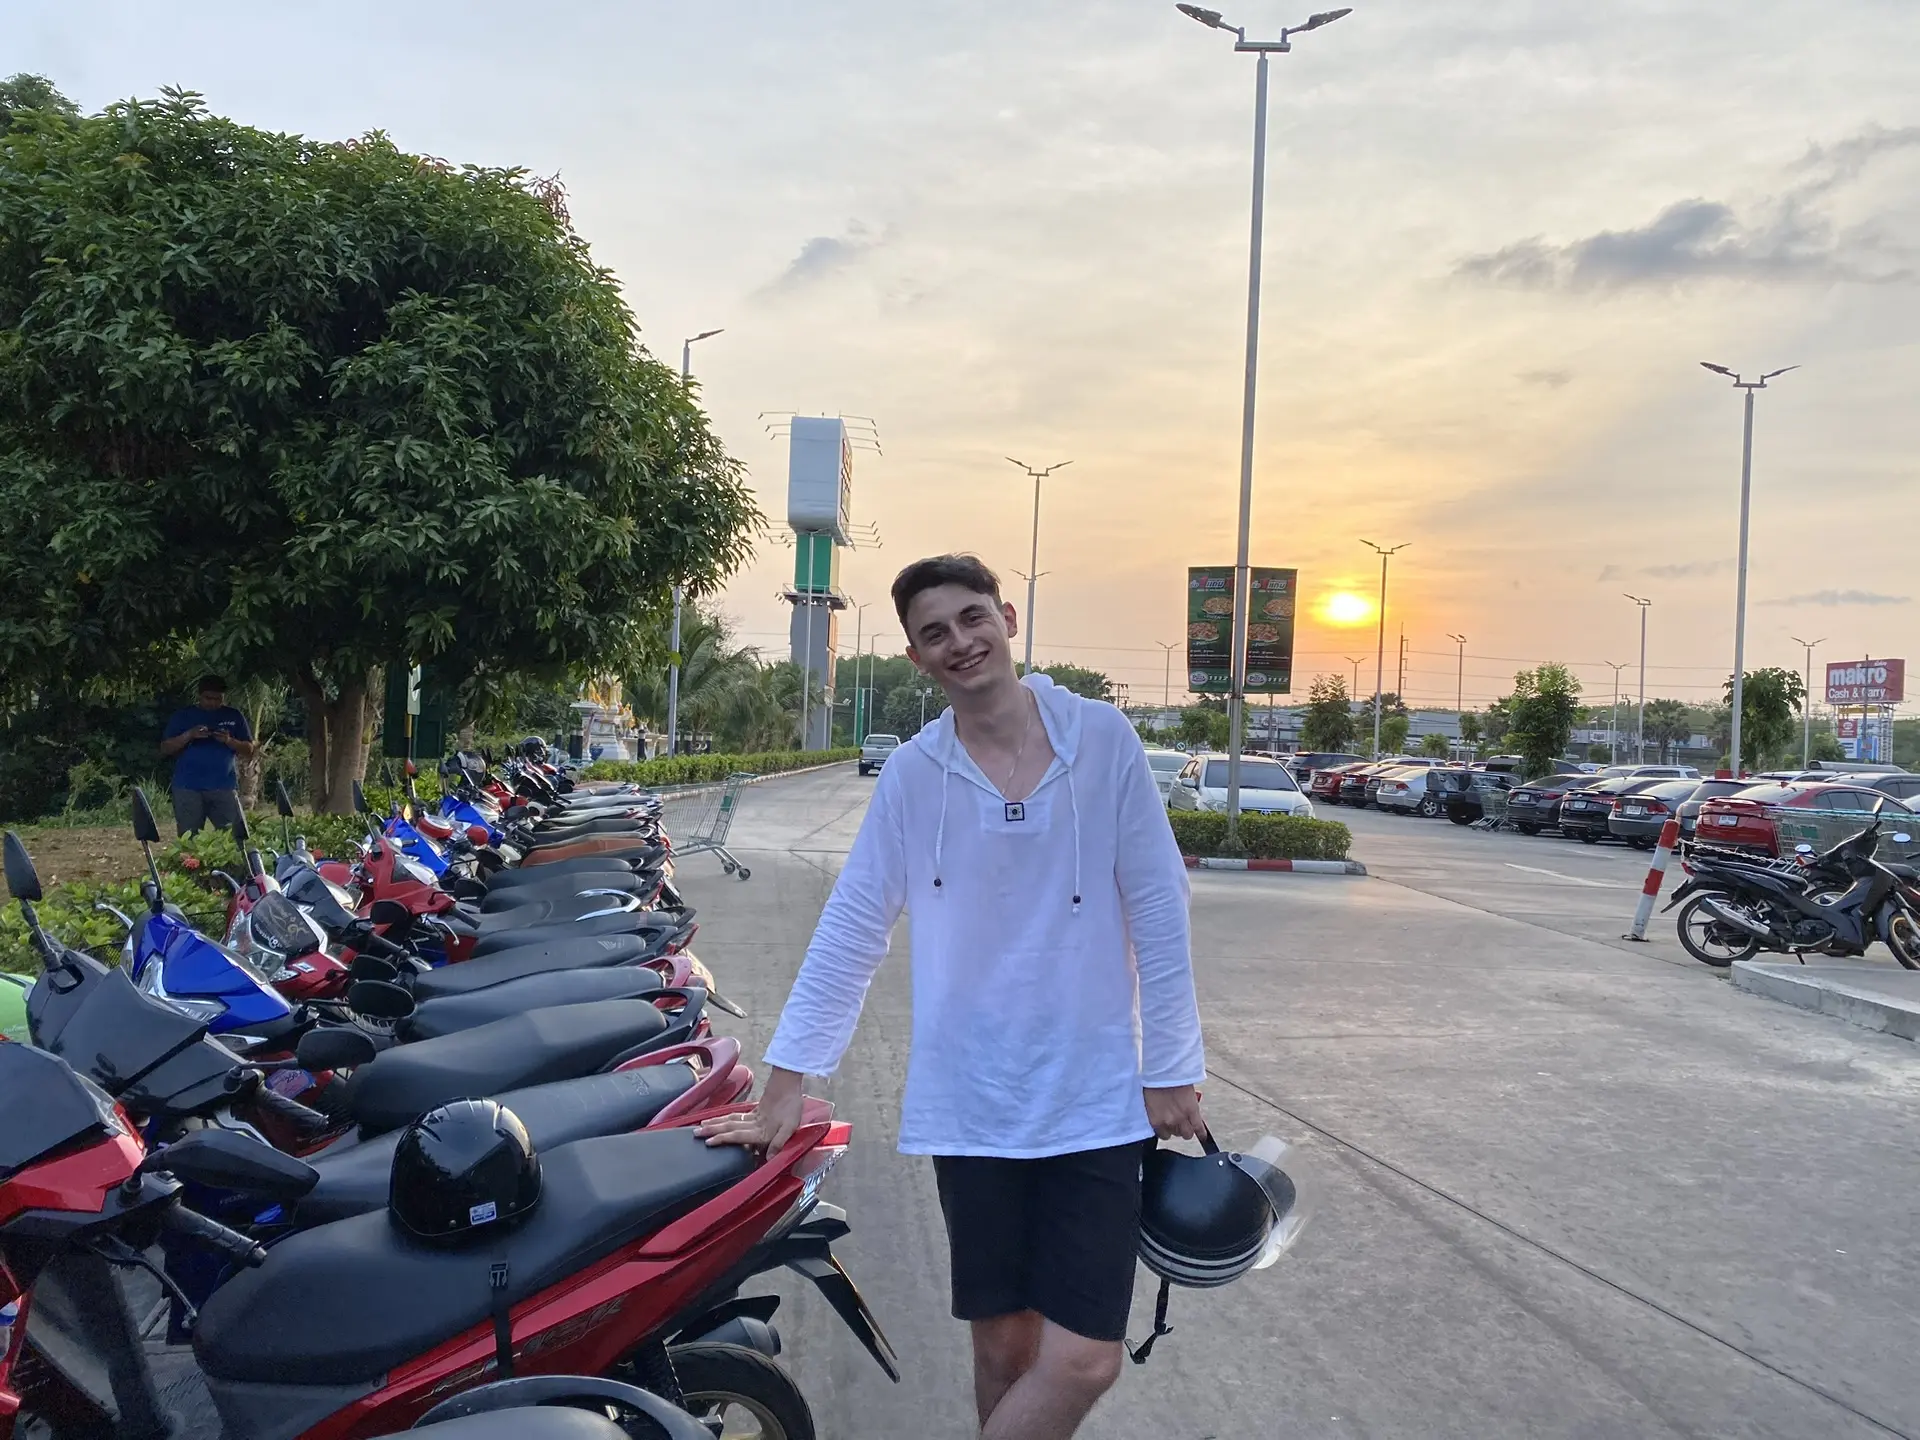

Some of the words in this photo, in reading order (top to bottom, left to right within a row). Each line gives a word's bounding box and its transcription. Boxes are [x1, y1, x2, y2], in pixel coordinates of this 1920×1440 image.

[1829, 663, 1887, 686] makro
[1828, 687, 1849, 698] Cash
[1852, 688, 1859, 698] &
